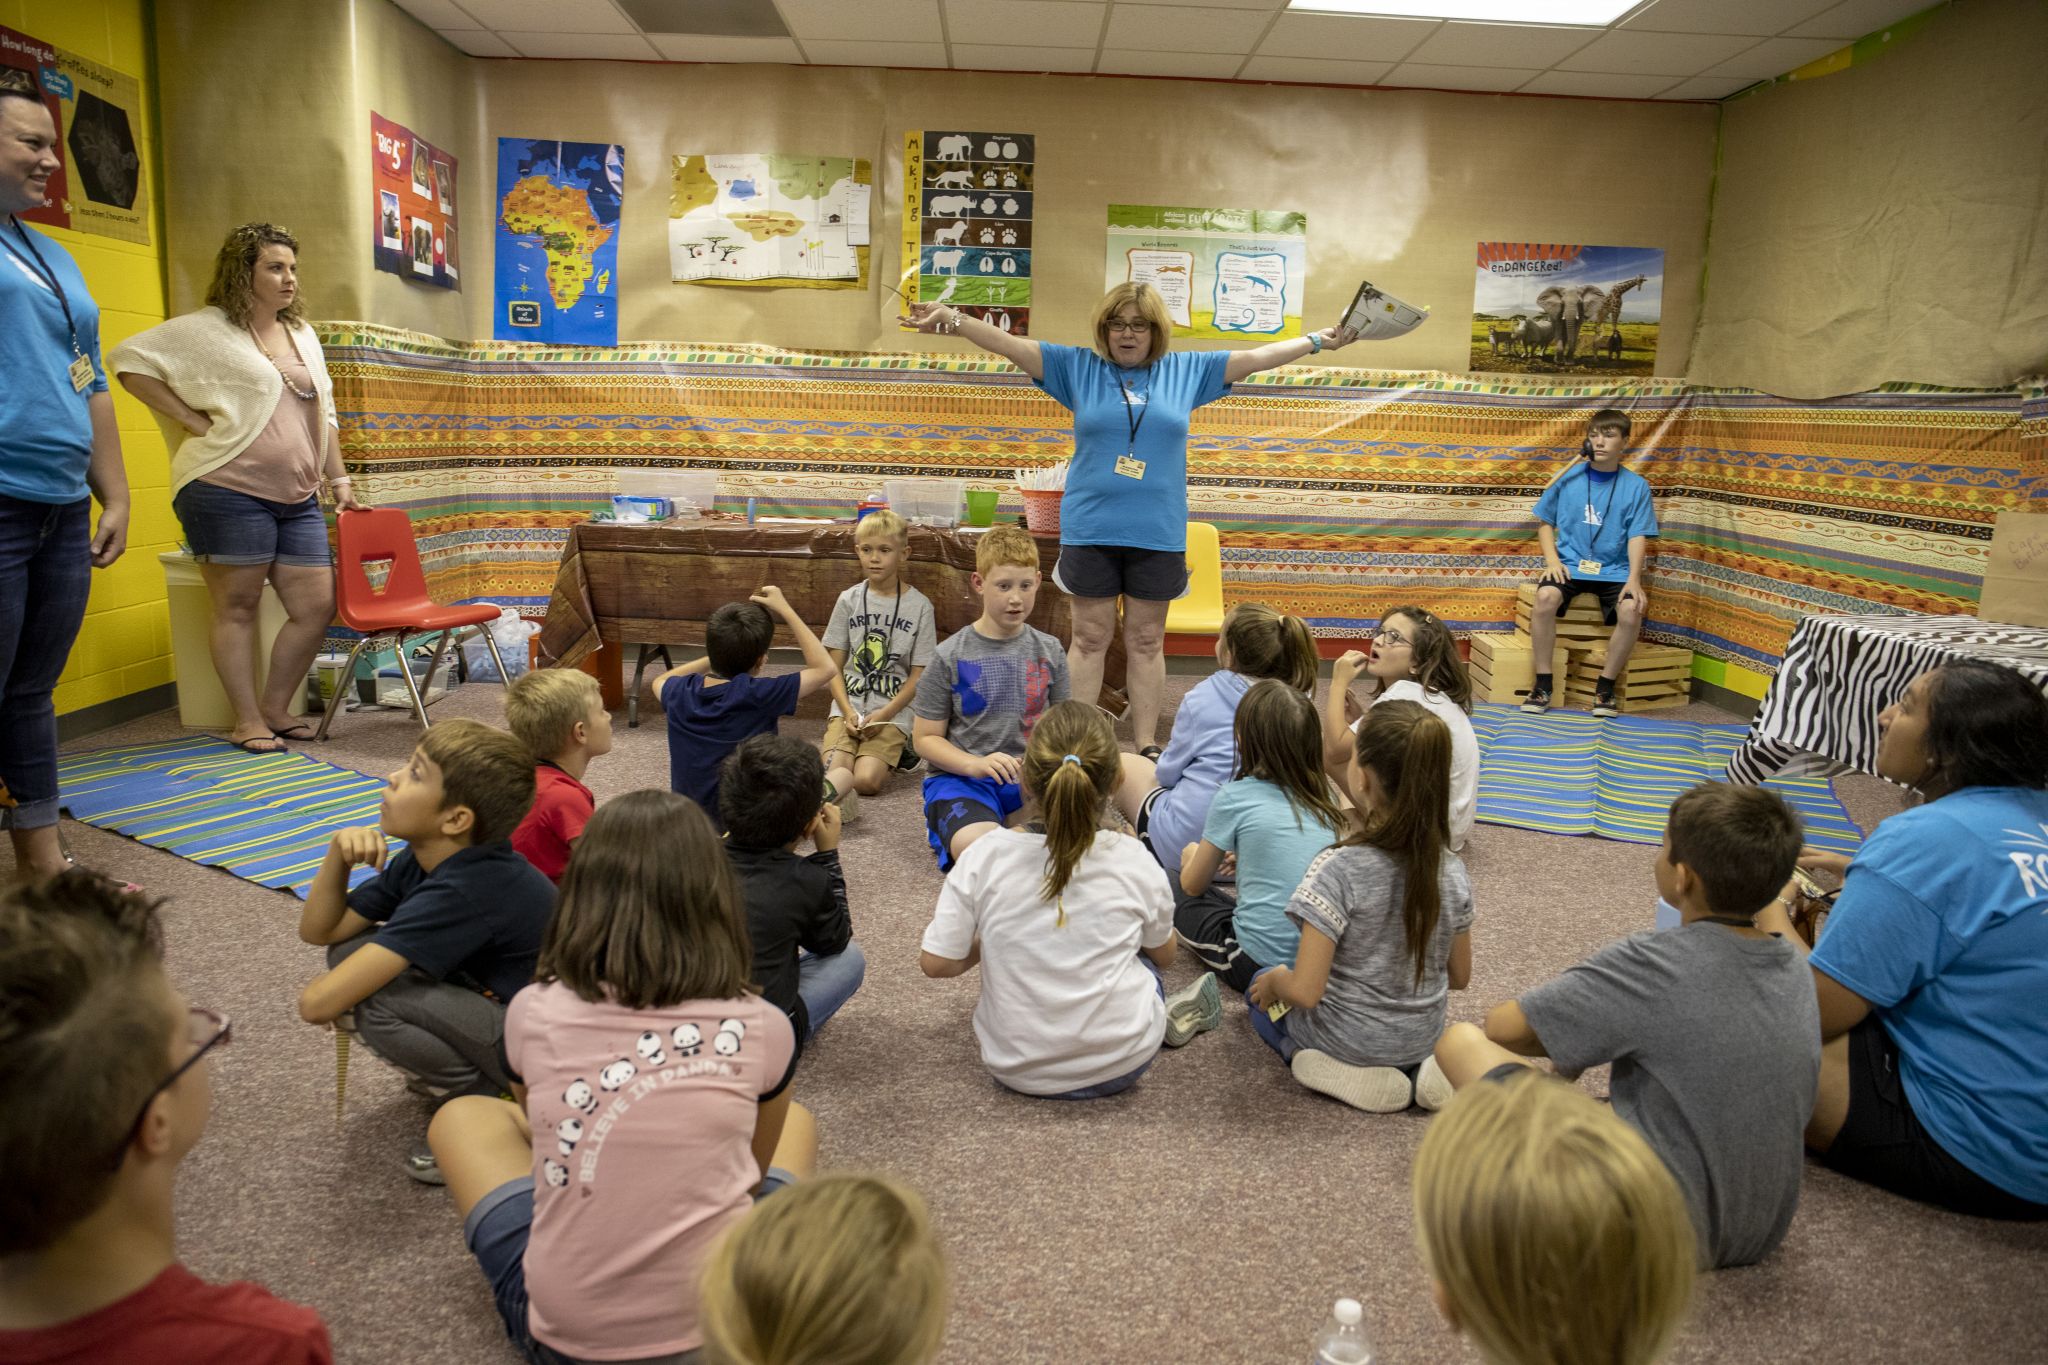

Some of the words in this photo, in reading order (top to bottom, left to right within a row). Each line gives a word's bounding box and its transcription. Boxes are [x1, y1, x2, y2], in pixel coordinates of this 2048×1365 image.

[1, 34, 21, 52] How
[23, 43, 42, 62] long
[43, 51, 54, 62] do
[907, 138, 920, 222] Making
[1491, 260, 1563, 273] enDANGERed!
[849, 613, 882, 630] ARTY
[579, 1096, 630, 1184] BELIEVE
[628, 1074, 658, 1101] IN
[660, 1059, 733, 1085] PANDA
